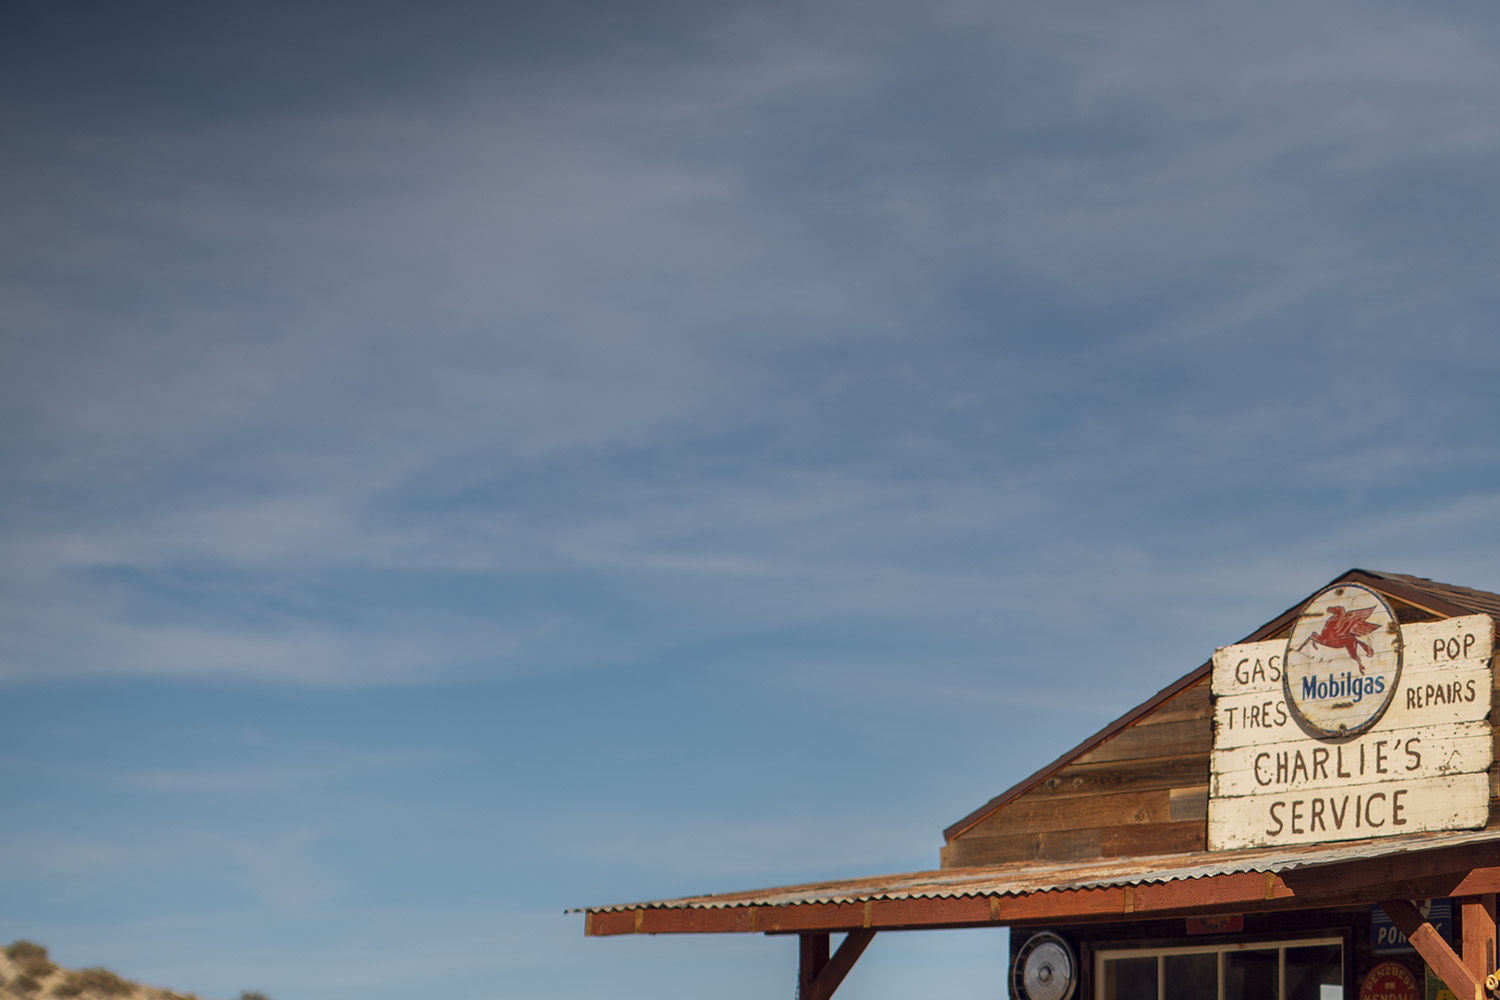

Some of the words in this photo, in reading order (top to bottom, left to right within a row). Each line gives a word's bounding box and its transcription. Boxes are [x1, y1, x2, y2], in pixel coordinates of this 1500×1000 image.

[1433, 633, 1476, 661] POP
[1235, 655, 1281, 685] GAS
[1302, 671, 1385, 703] Mobilgas
[1406, 679, 1476, 710] REPAIRS
[1224, 700, 1288, 730] TIRES
[1254, 738, 1422, 786] CHARLIE'S
[1266, 789, 1409, 837] SERVICE
